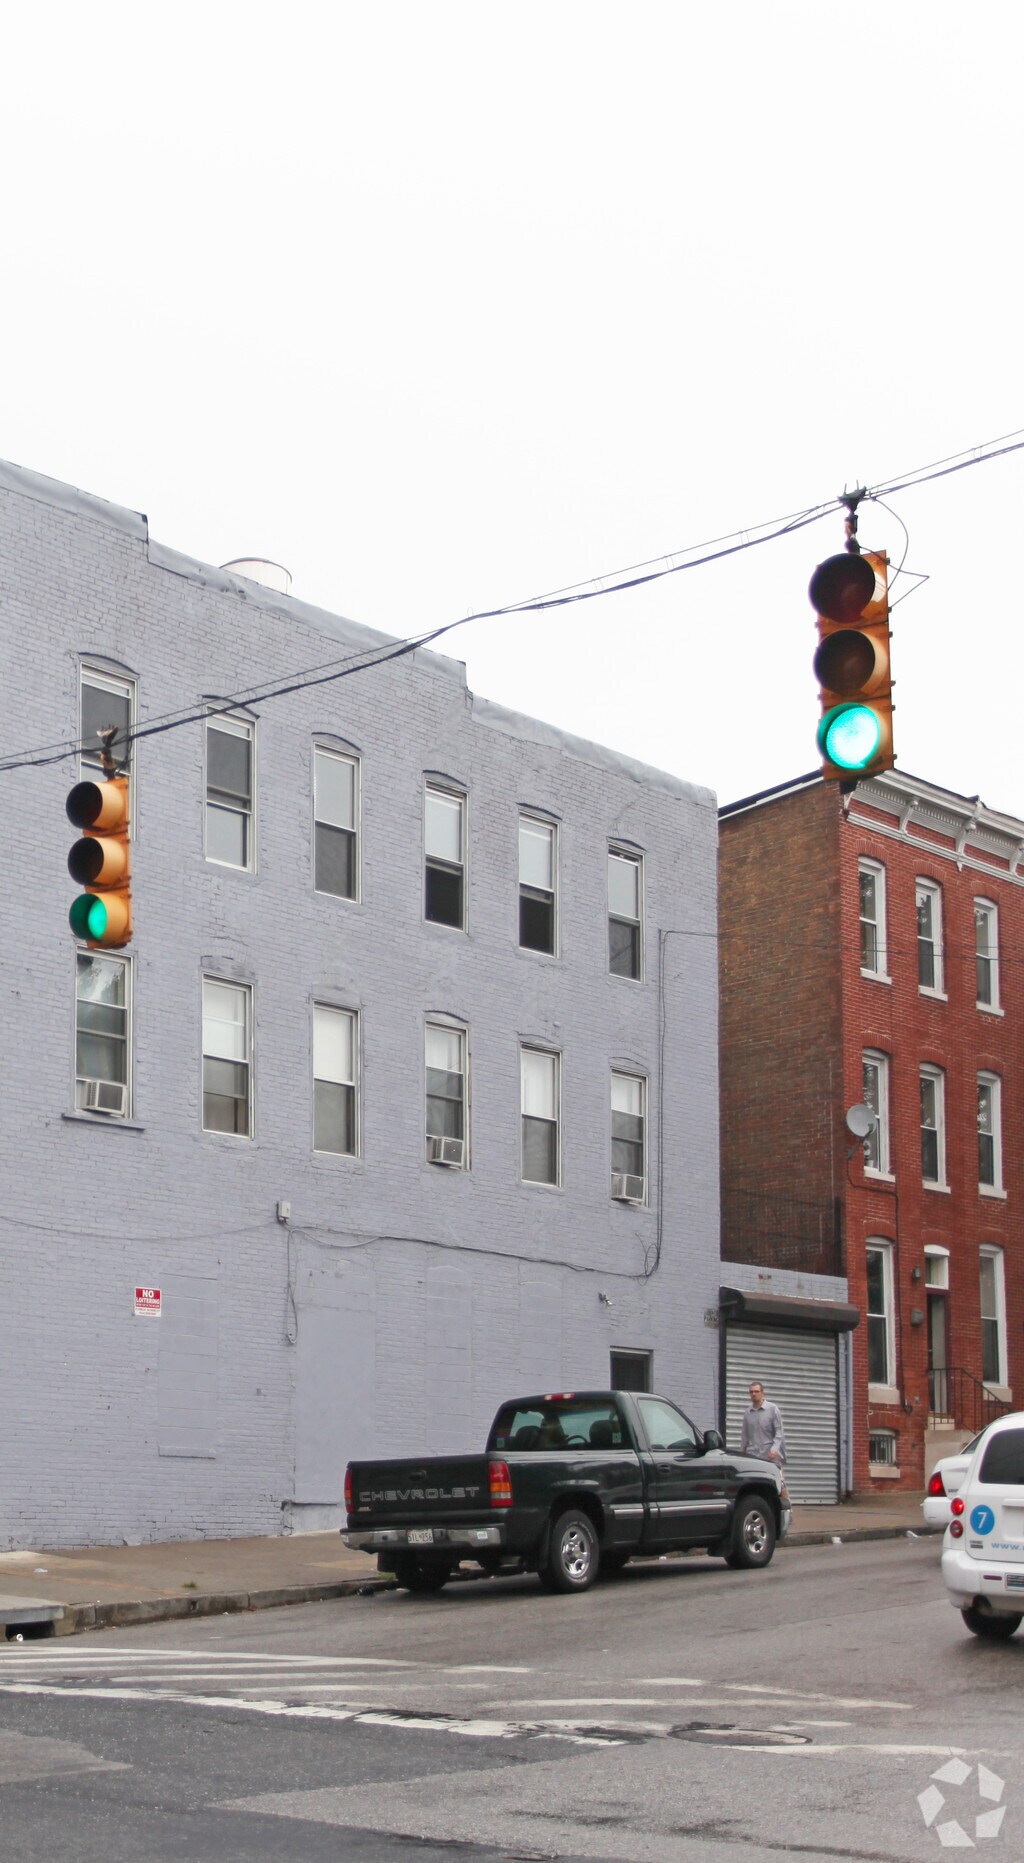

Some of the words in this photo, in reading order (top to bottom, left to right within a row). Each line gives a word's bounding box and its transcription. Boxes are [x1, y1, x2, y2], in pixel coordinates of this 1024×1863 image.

[142, 1289, 154, 1298] NO
[359, 1487, 479, 1502] CHEVROLET
[978, 1511, 987, 1529] 7
